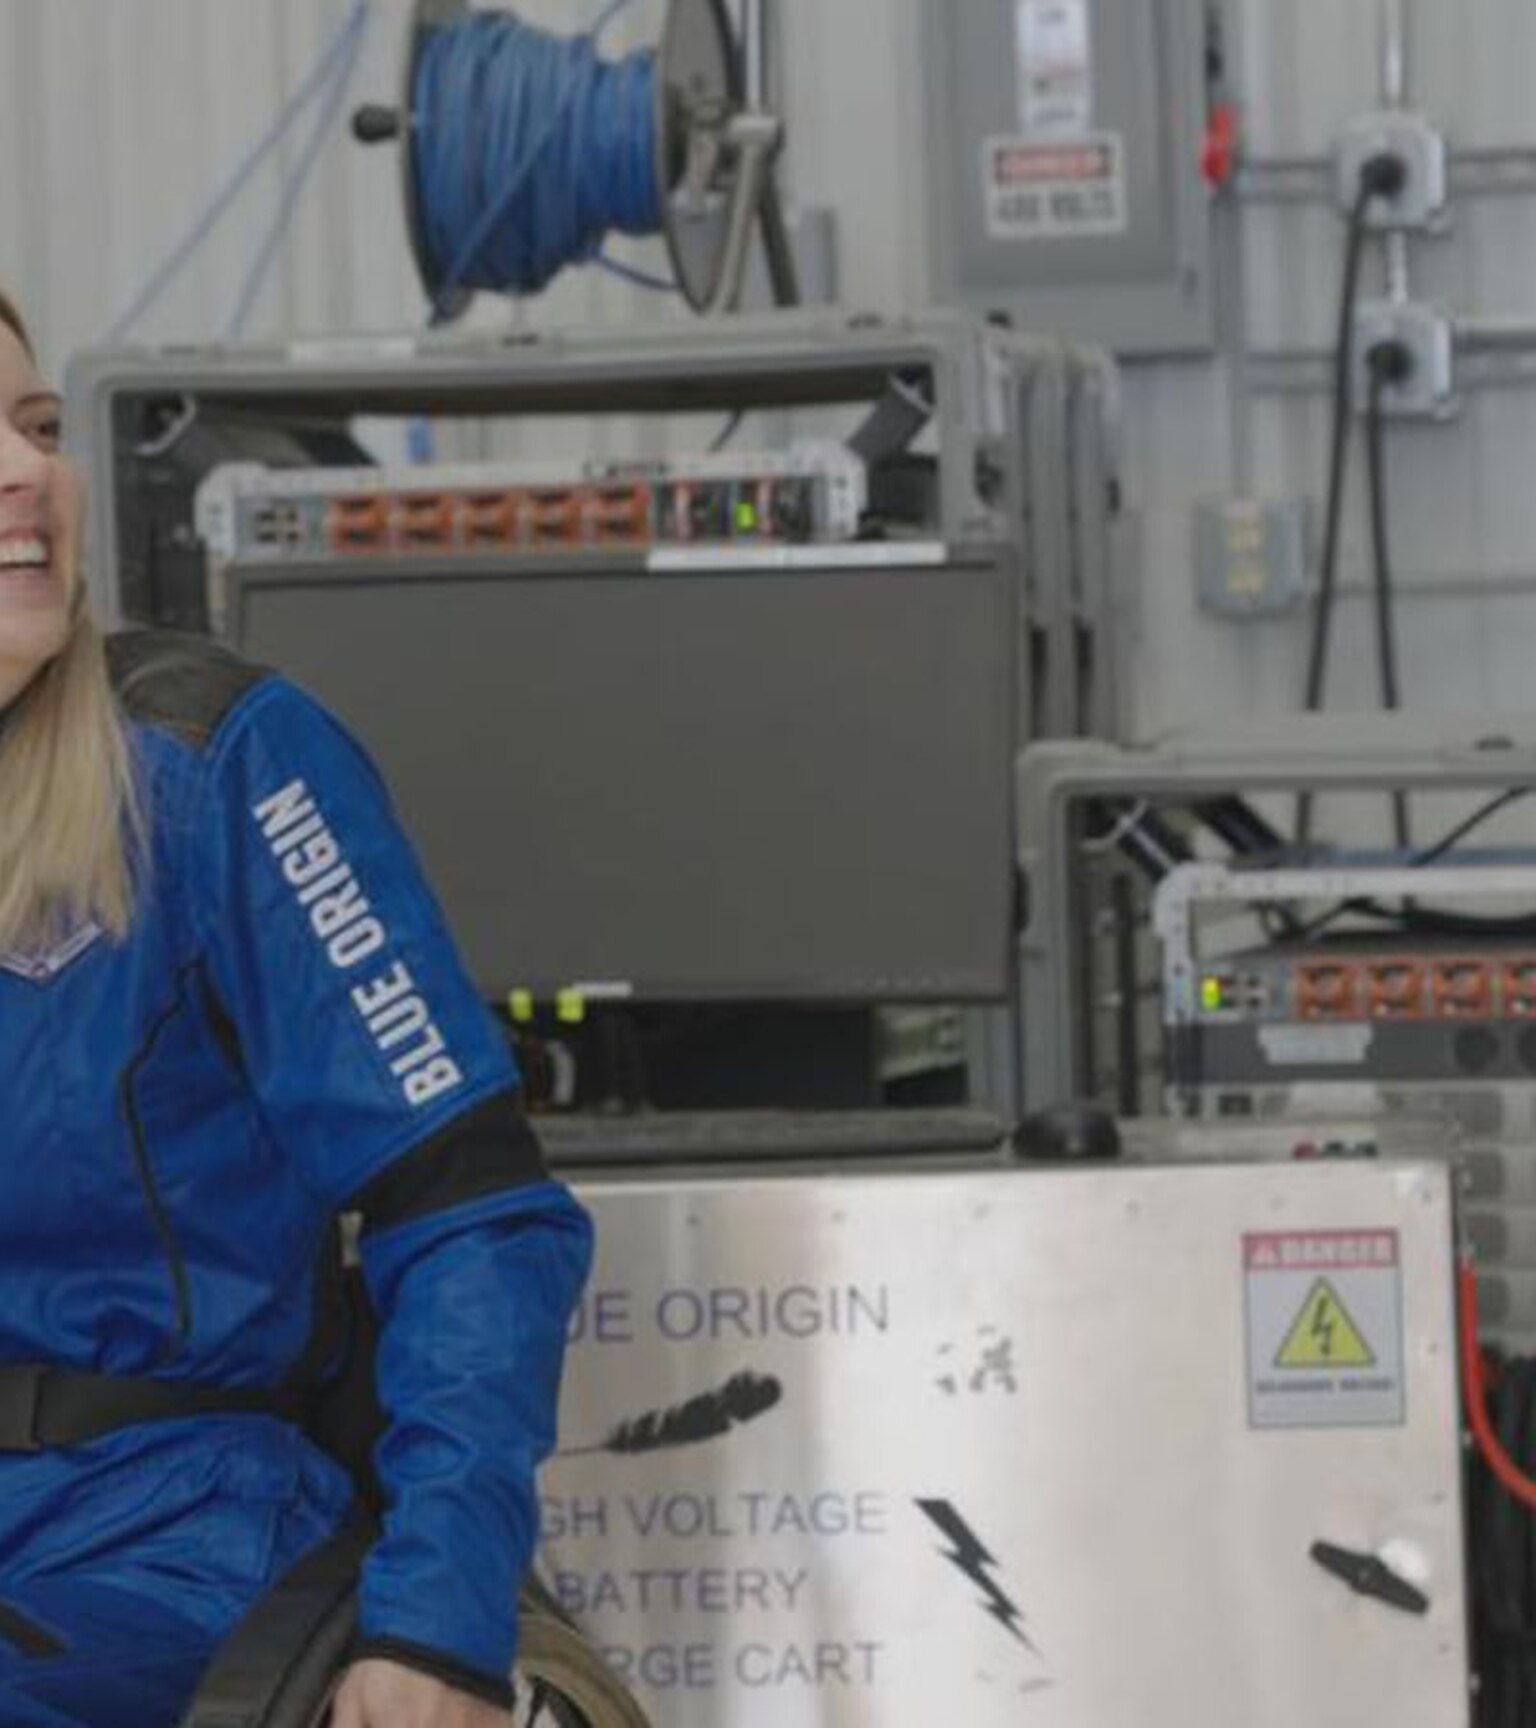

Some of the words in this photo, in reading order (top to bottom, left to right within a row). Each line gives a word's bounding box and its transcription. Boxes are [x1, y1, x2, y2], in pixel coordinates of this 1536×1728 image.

[253, 777, 386, 969] ORIGIN
[350, 960, 463, 1105] BLUE
[656, 1284, 889, 1341] ORIGIN
[540, 1495, 607, 1539] GH
[624, 1491, 887, 1537] VOLTAGE
[554, 1568, 808, 1614] BATTERY
[600, 1643, 716, 1690] RGE
[735, 1641, 887, 1688] CART
